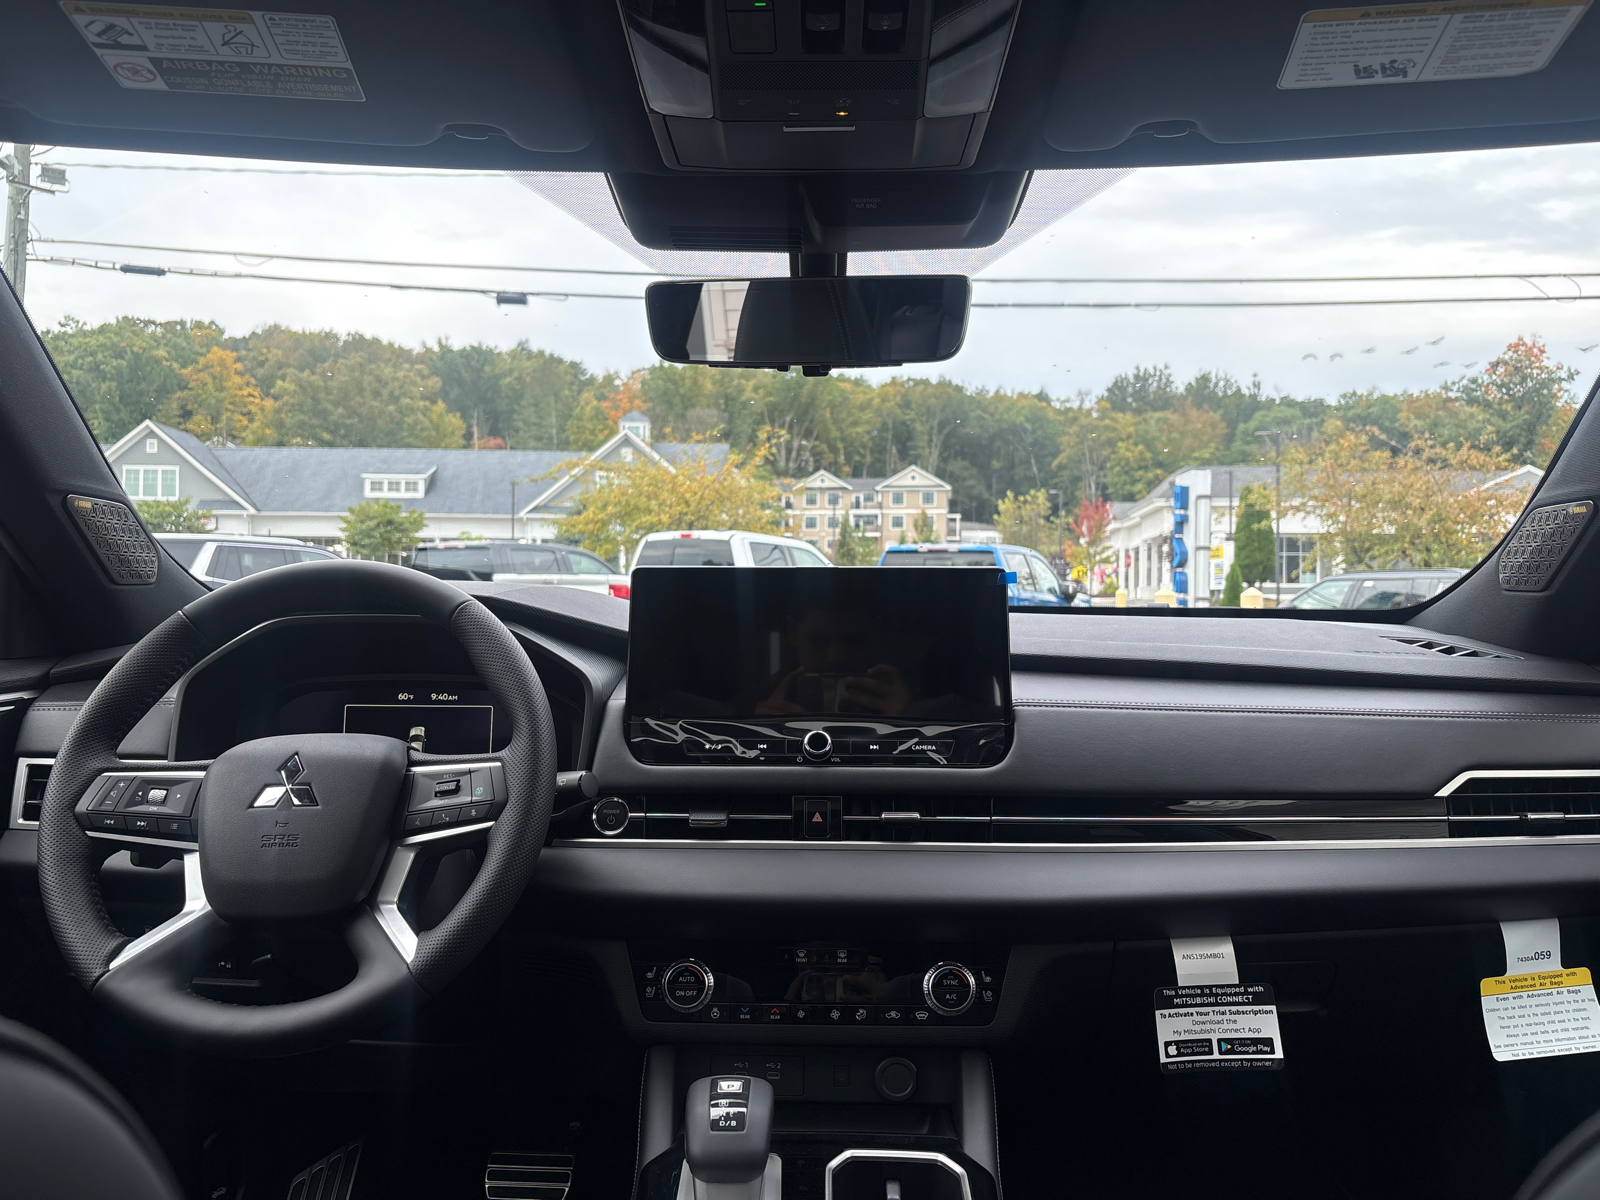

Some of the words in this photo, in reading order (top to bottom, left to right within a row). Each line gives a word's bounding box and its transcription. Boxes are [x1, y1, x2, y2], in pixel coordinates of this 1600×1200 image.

[158, 60, 241, 72] AIRBAG
[250, 64, 348, 78] WARNING
[163, 76, 210, 84] COUSSIN
[212, 78, 274, 88] GONFLABLE
[276, 82, 358, 93] AVERTISSEMENT
[1212, 986, 1245, 994] Equipped
[1566, 988, 1581, 996] Bags
[1174, 996, 1216, 1005] MITSUBISHI
[1217, 995, 1253, 1003] CONNECT
[1248, 1026, 1262, 1035] App
